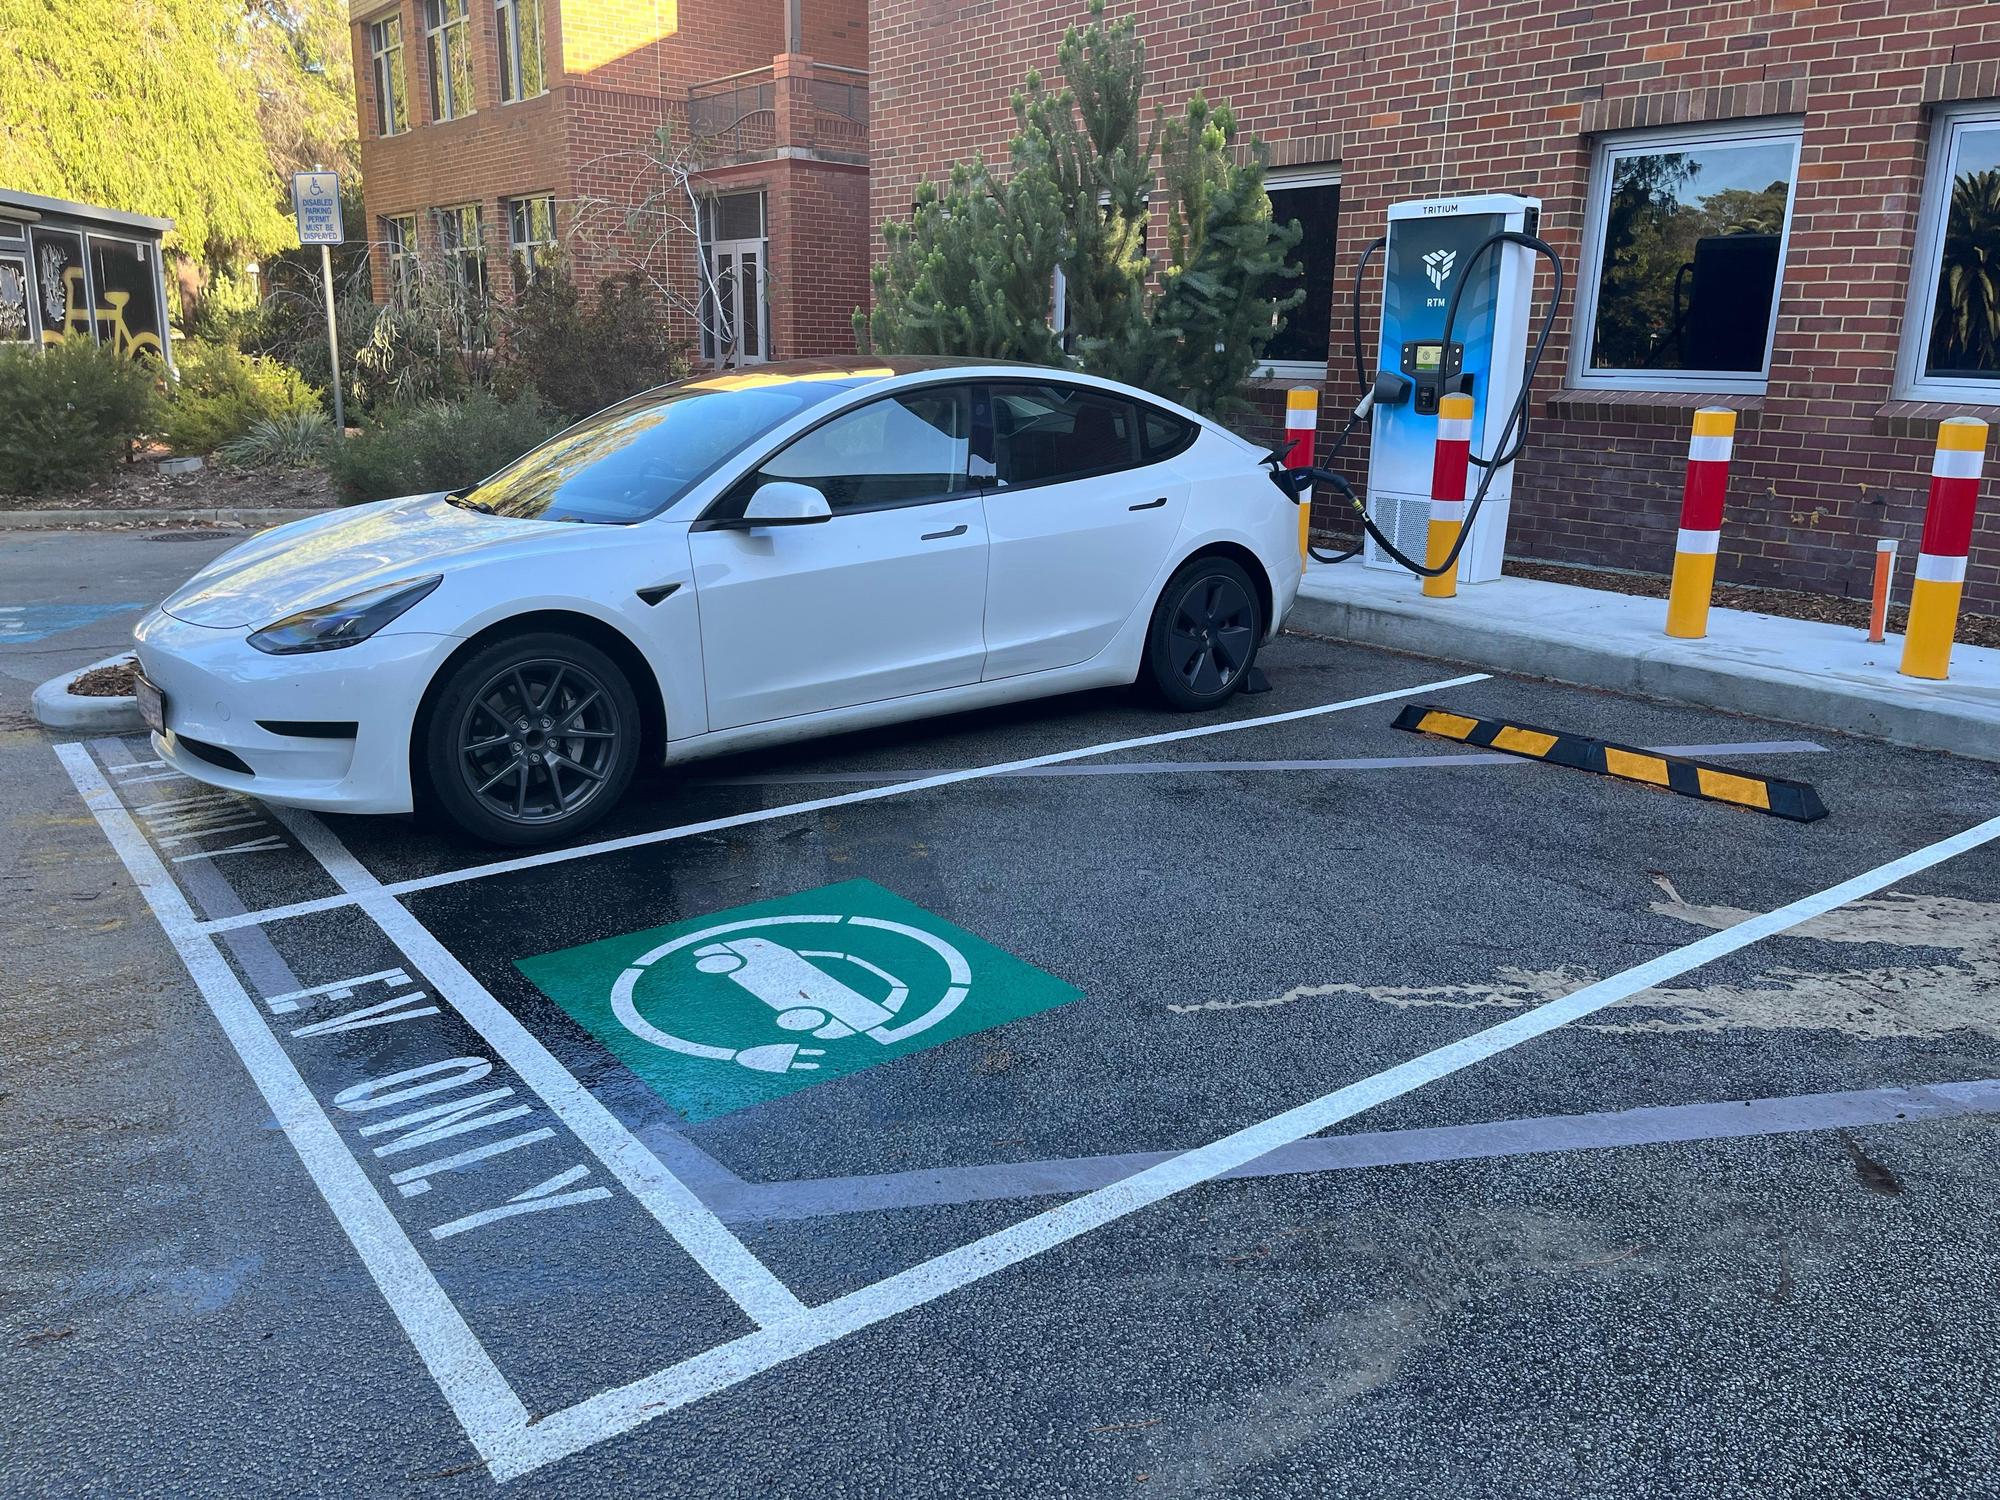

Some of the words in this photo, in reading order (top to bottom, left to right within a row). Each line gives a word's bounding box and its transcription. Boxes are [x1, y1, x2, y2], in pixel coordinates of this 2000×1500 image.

[1423, 204, 1458, 214] TRITIUM
[304, 232, 337, 240] DISPLAYED
[1426, 298, 1446, 307] RTM
[265, 966, 442, 1038] EV
[333, 1055, 614, 1241] ONLY
